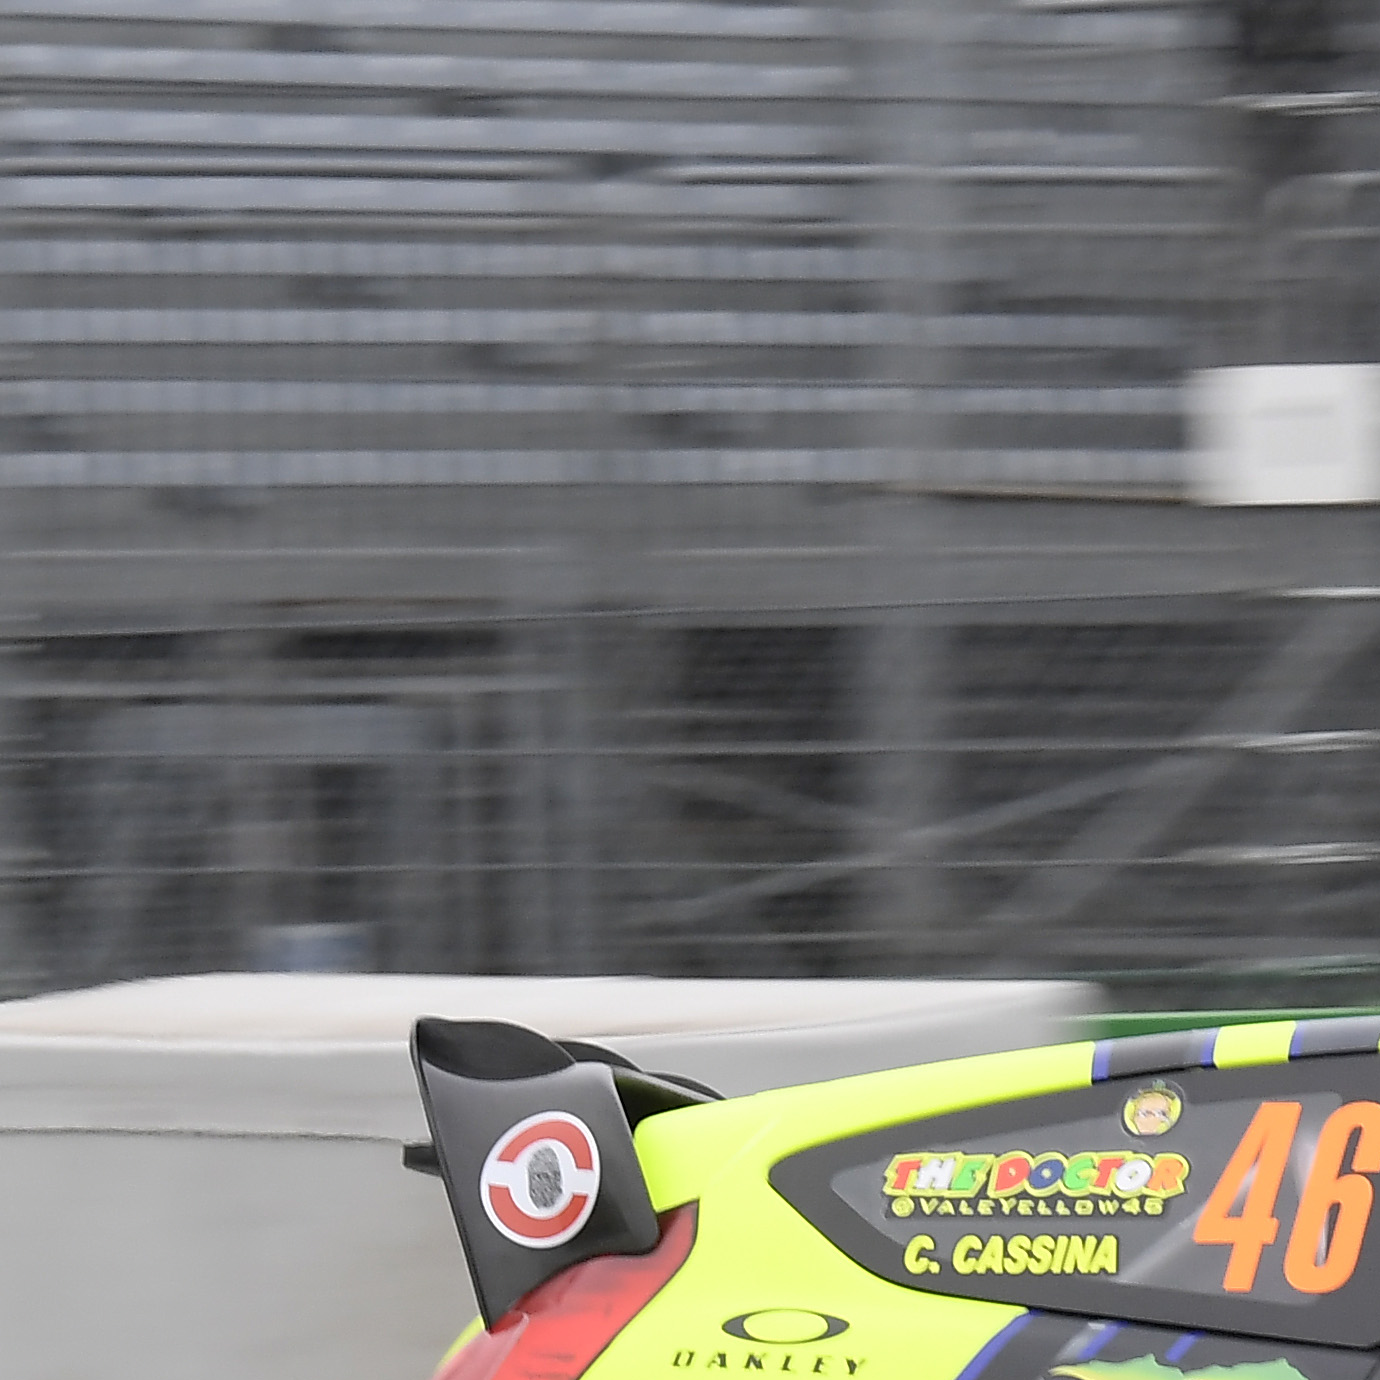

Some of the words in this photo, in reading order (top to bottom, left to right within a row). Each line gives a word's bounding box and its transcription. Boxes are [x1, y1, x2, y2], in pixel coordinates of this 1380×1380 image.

[886, 1152, 994, 1198] THE
[988, 1151, 1189, 1198] DOCTOR
[904, 1234, 941, 1274] C.
[952, 1235, 1118, 1275] CASSINA
[673, 1351, 866, 1376] OAKLEY
